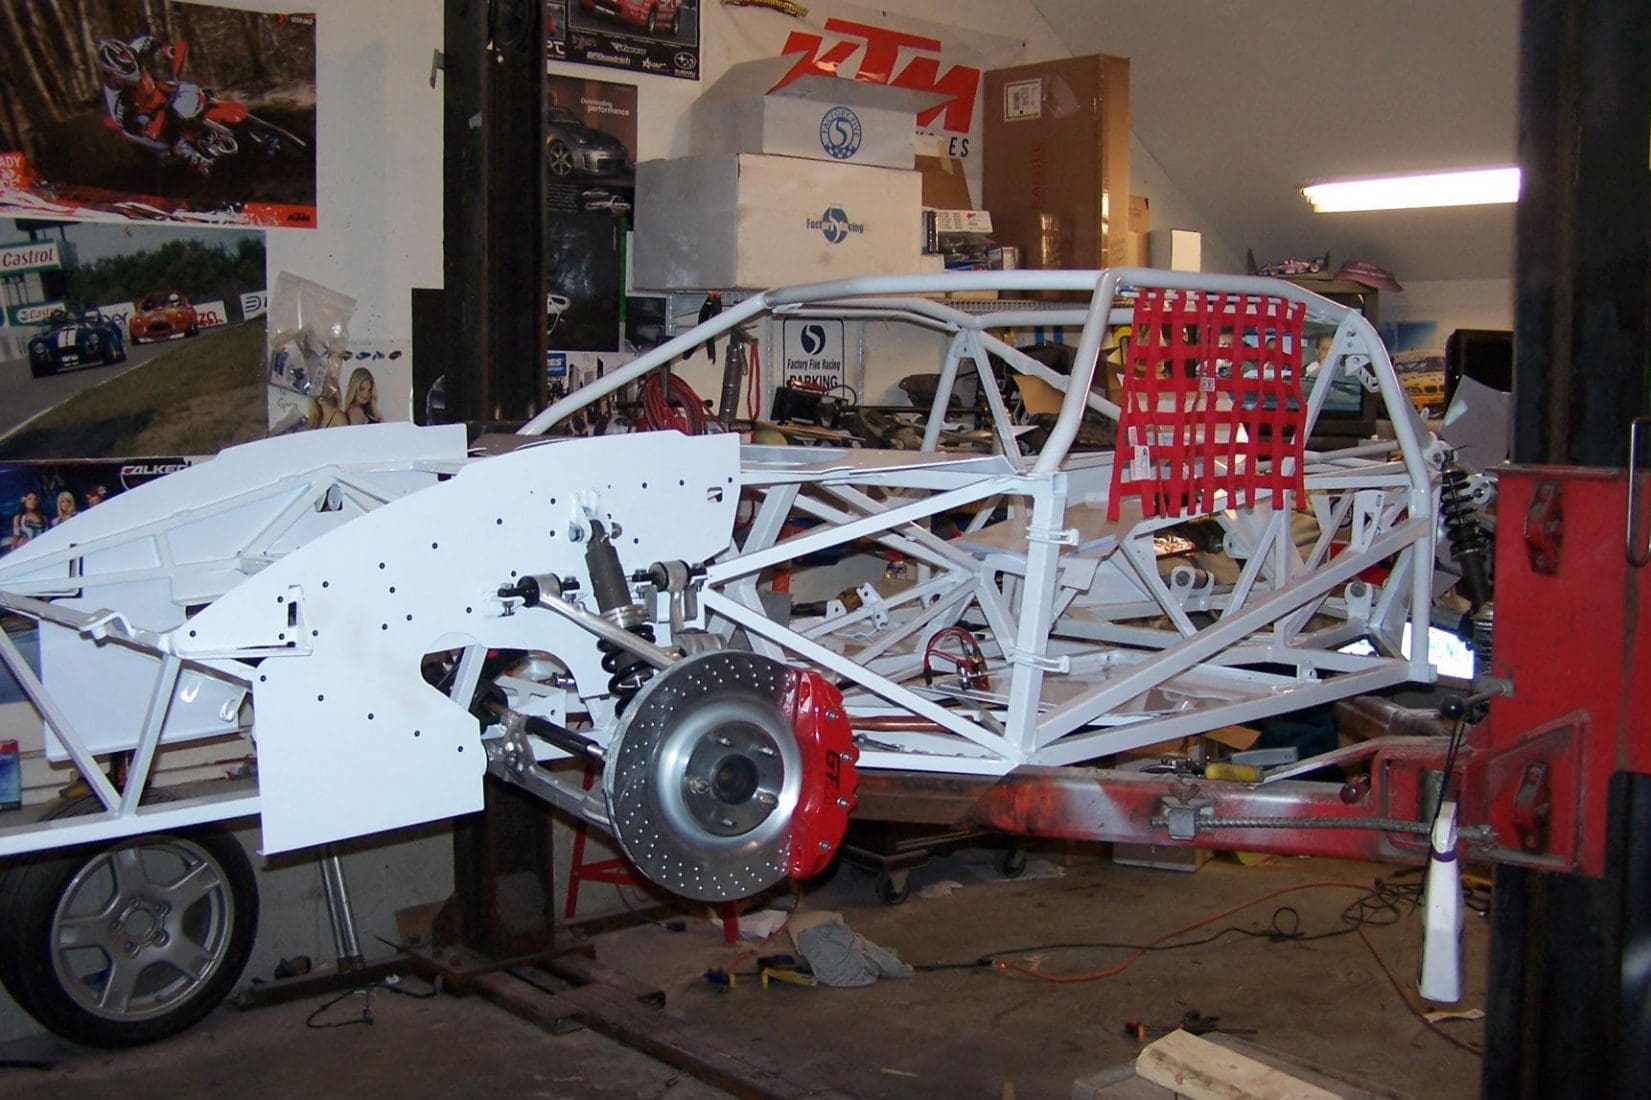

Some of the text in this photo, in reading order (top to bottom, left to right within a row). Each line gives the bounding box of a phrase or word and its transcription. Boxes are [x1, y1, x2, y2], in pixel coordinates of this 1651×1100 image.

[2, 247, 54, 268] Castrol
[786, 358, 841, 372] Factory Five Racing
